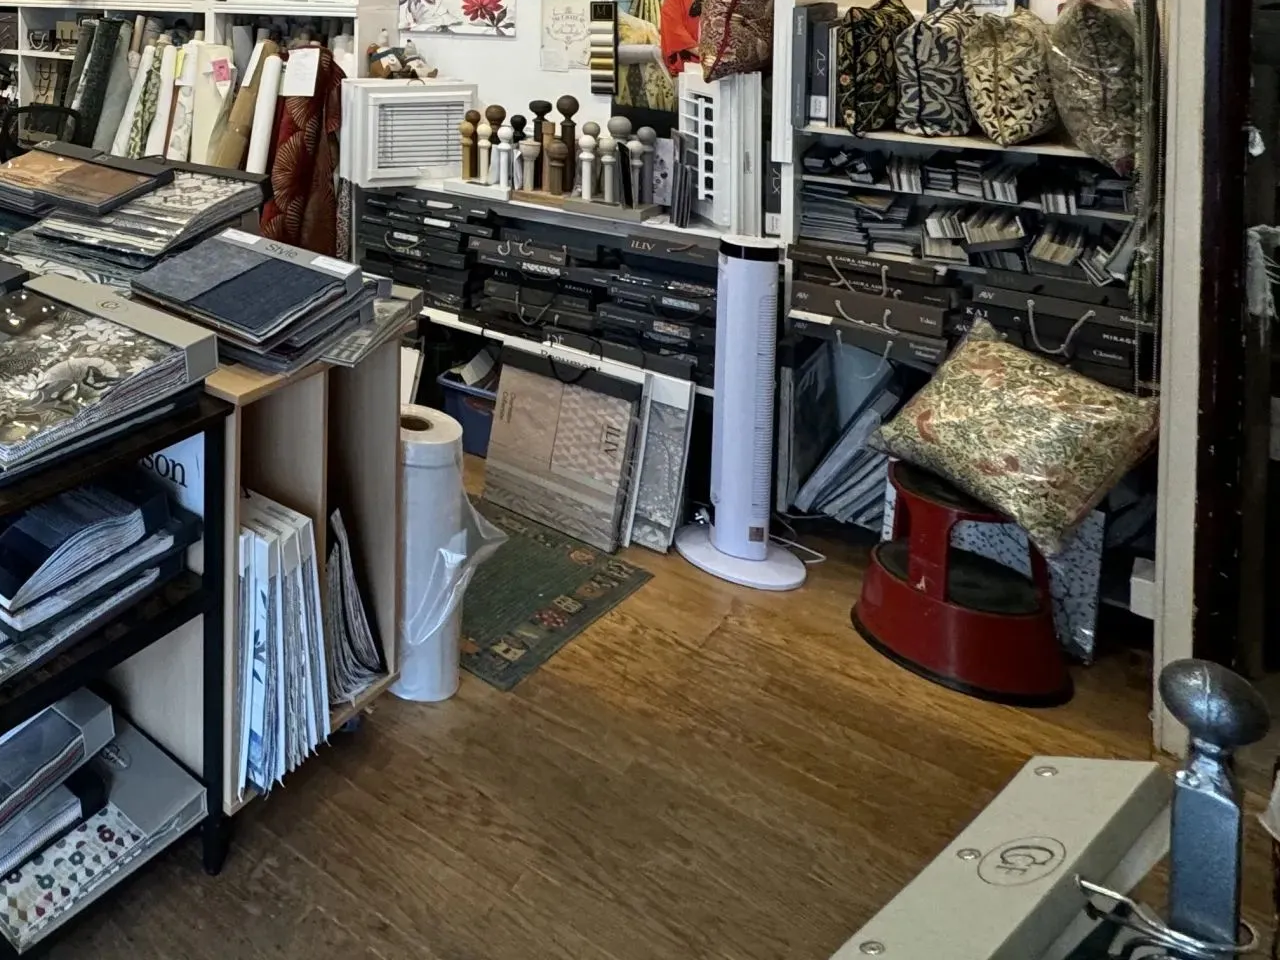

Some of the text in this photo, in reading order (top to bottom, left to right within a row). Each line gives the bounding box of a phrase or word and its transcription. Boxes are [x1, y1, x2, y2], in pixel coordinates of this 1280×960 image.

[264, 243, 298, 258] Style
[630, 240, 655, 251] ILIV
[965, 306, 988, 317] KAI
